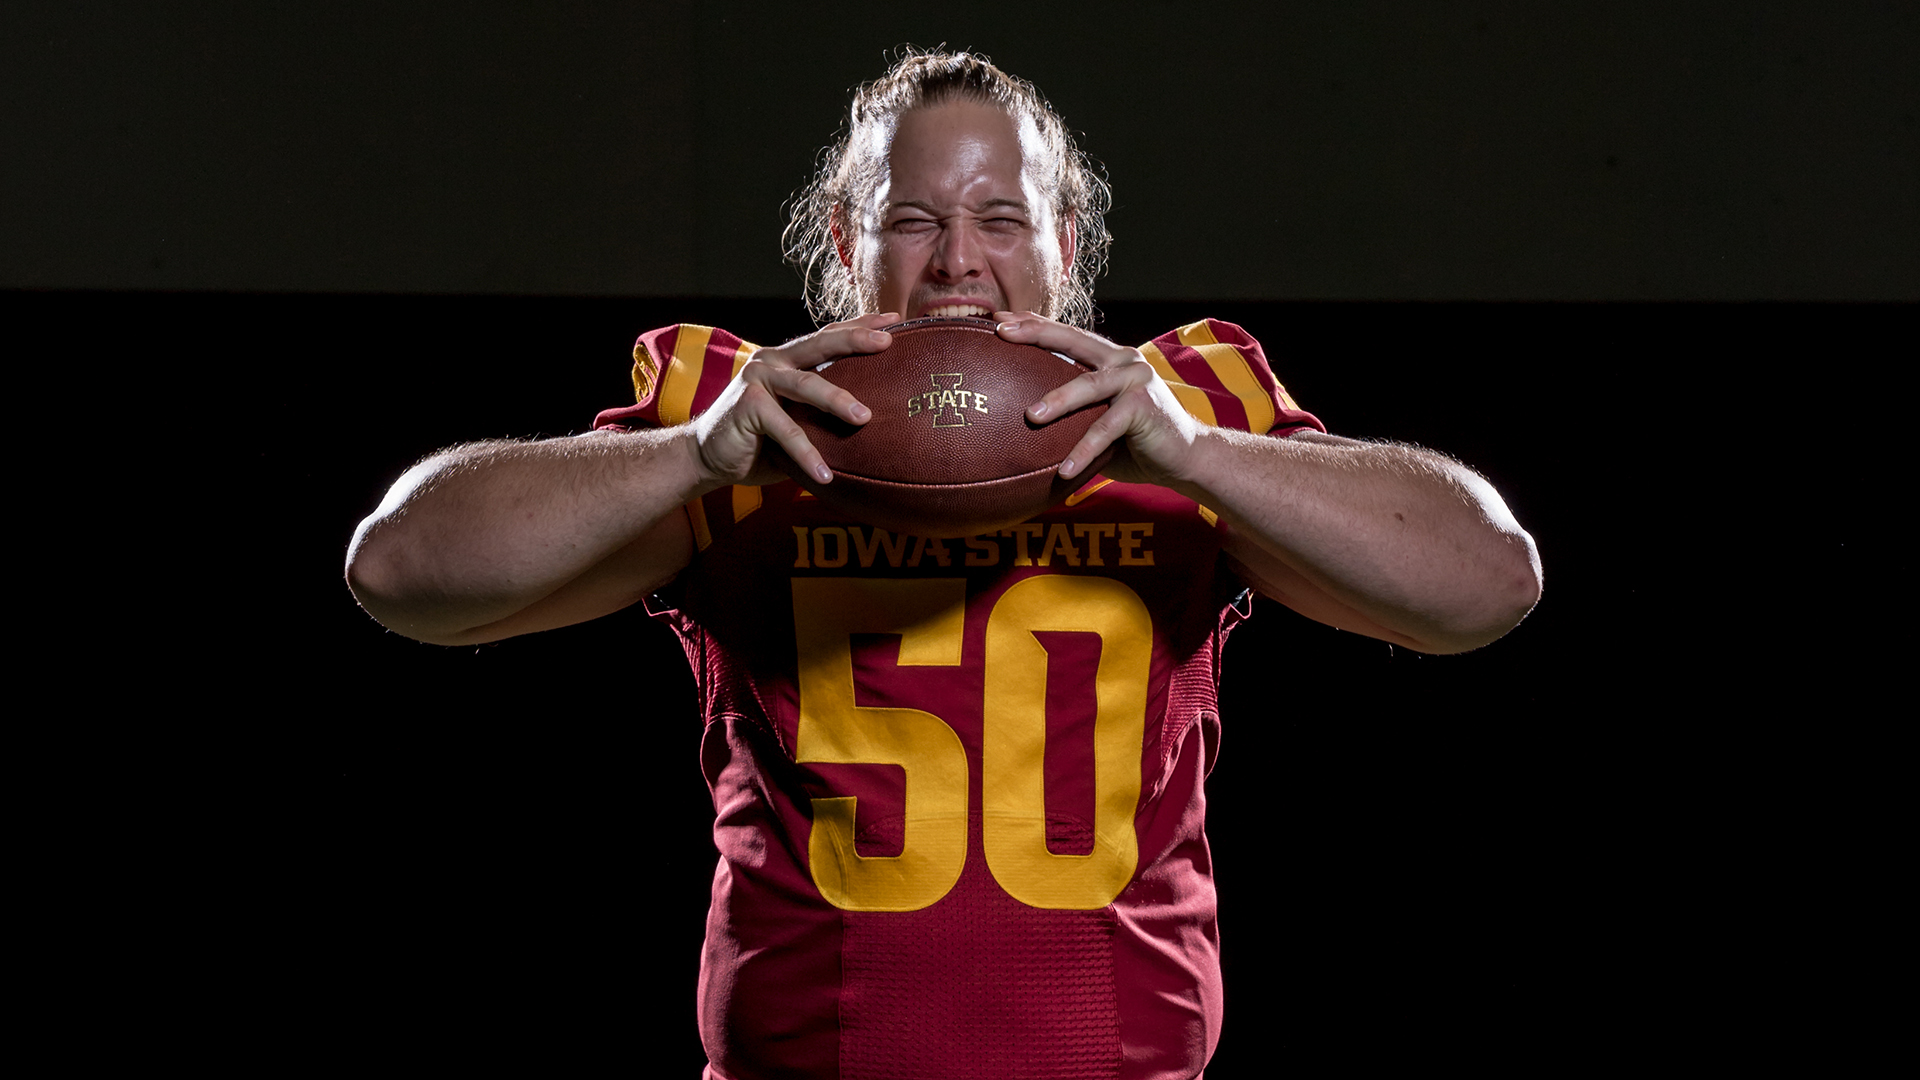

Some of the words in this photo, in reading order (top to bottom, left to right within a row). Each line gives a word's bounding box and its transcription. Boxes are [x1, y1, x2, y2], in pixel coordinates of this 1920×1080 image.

[907, 390, 989, 418] STATE
[792, 525, 952, 569] IOWA
[964, 522, 1155, 567] STATE
[791, 574, 1153, 912] 50
